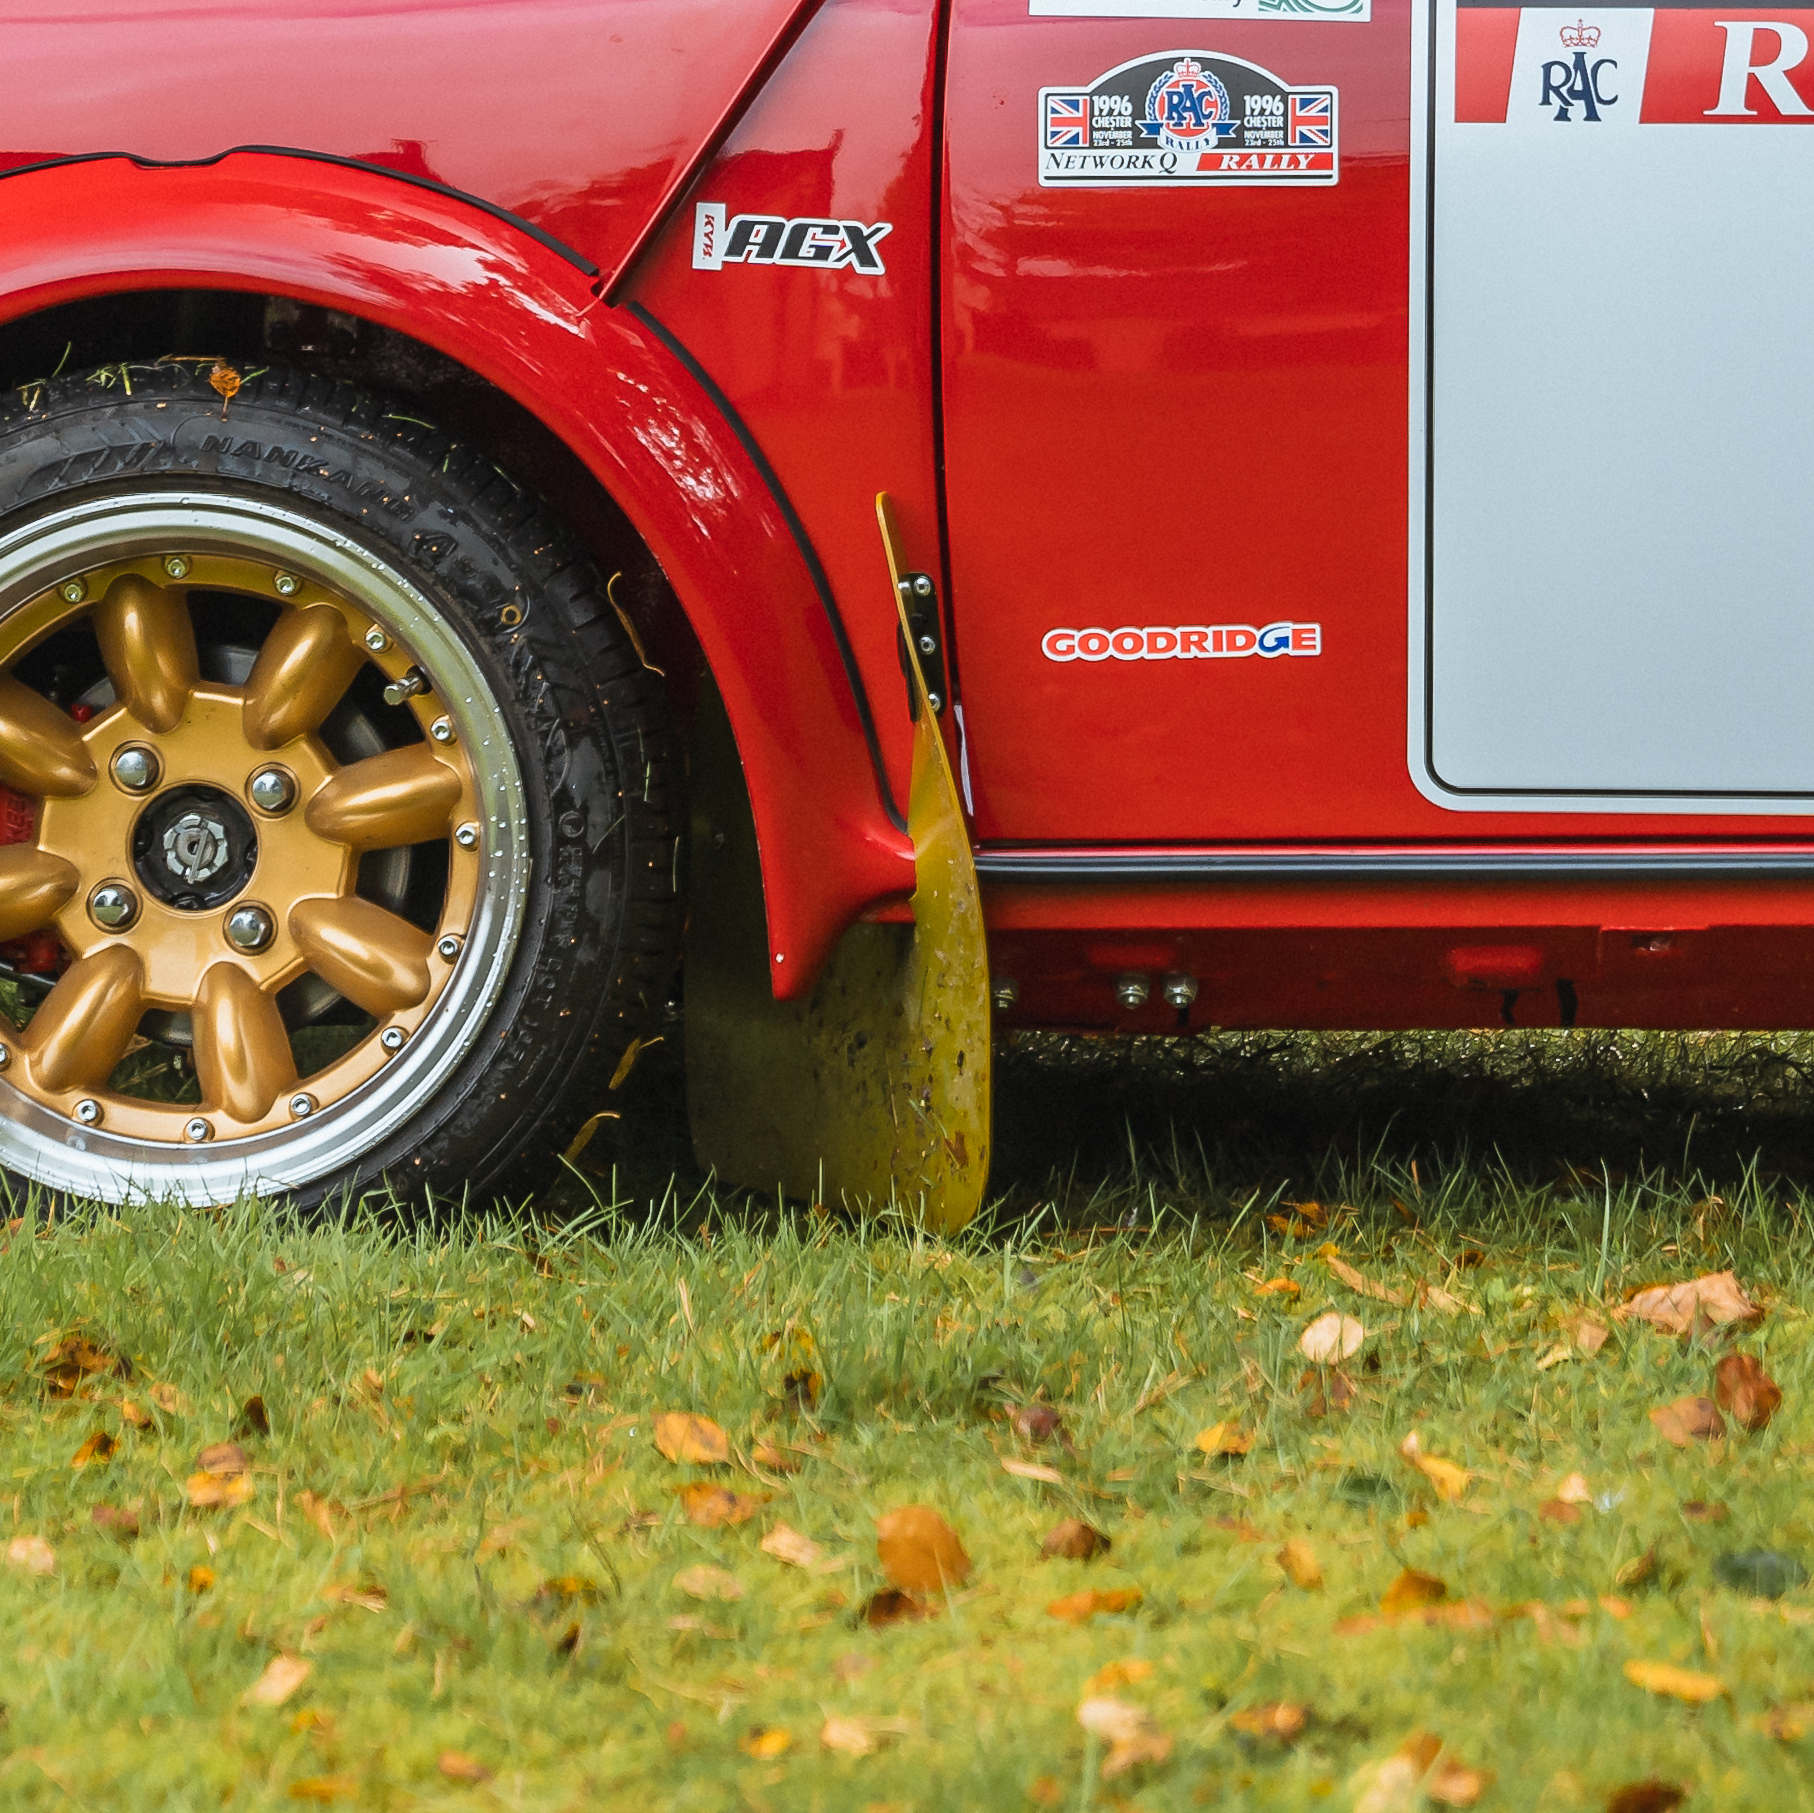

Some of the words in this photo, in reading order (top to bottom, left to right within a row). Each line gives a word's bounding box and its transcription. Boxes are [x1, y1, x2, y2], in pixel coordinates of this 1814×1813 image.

[1538, 52, 1619, 122] RAC
[1091, 95, 1133, 116] 1996
[1164, 83, 1215, 128] RAC
[1243, 95, 1284, 116] 1996
[1091, 116, 1133, 128] CHESTER
[1243, 116, 1284, 128] CHESTER
[1092, 130, 1133, 139] NOVEMBER
[1165, 135, 1211, 151] RALLY
[1244, 130, 1285, 139] NOVEMBER
[1218, 153, 1315, 170] RALLY
[702, 214, 715, 258] KYB
[723, 219, 887, 268] AGX
[198, 434, 415, 522] NANKANG
[1046, 626, 1318, 656] GOODRIDGE
